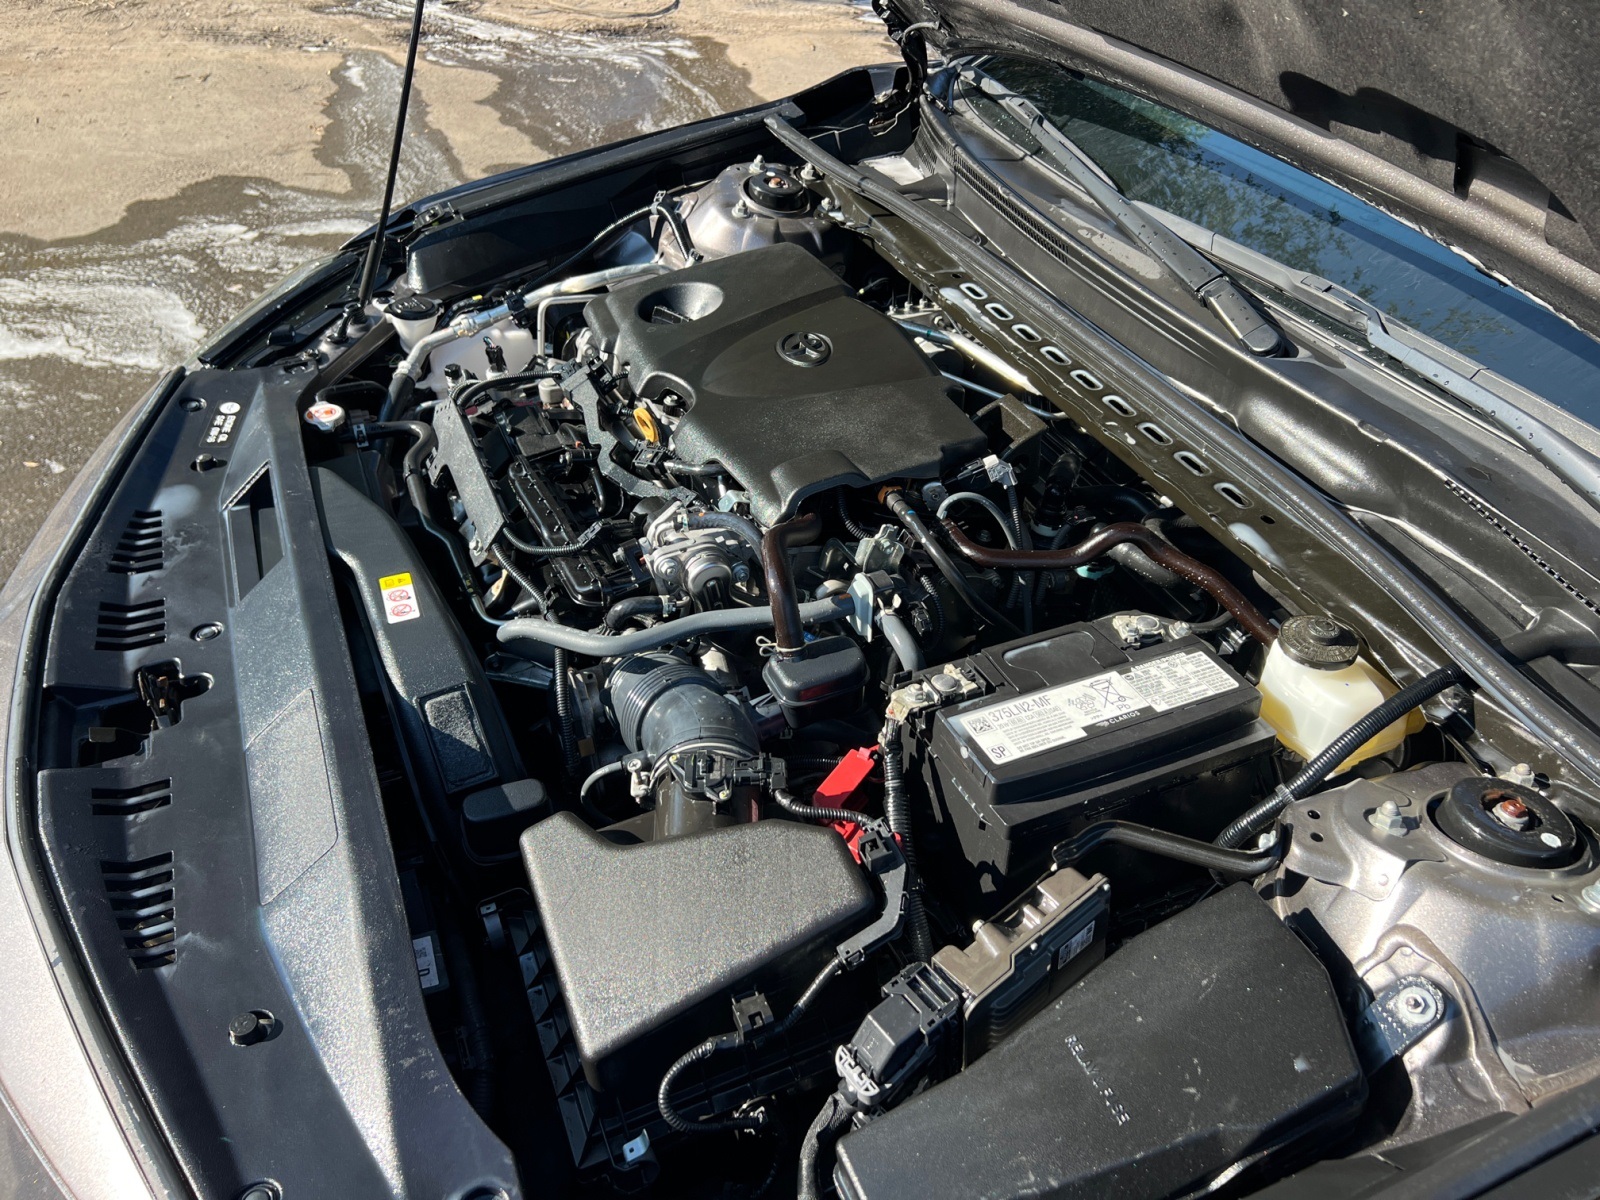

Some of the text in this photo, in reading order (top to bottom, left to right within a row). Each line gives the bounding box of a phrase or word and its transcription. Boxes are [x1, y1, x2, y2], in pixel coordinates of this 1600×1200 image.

[988, 695, 1051, 722] 375LN2-MF
[1109, 710, 1140, 724] CLARIOS
[991, 746, 1006, 759] SP
